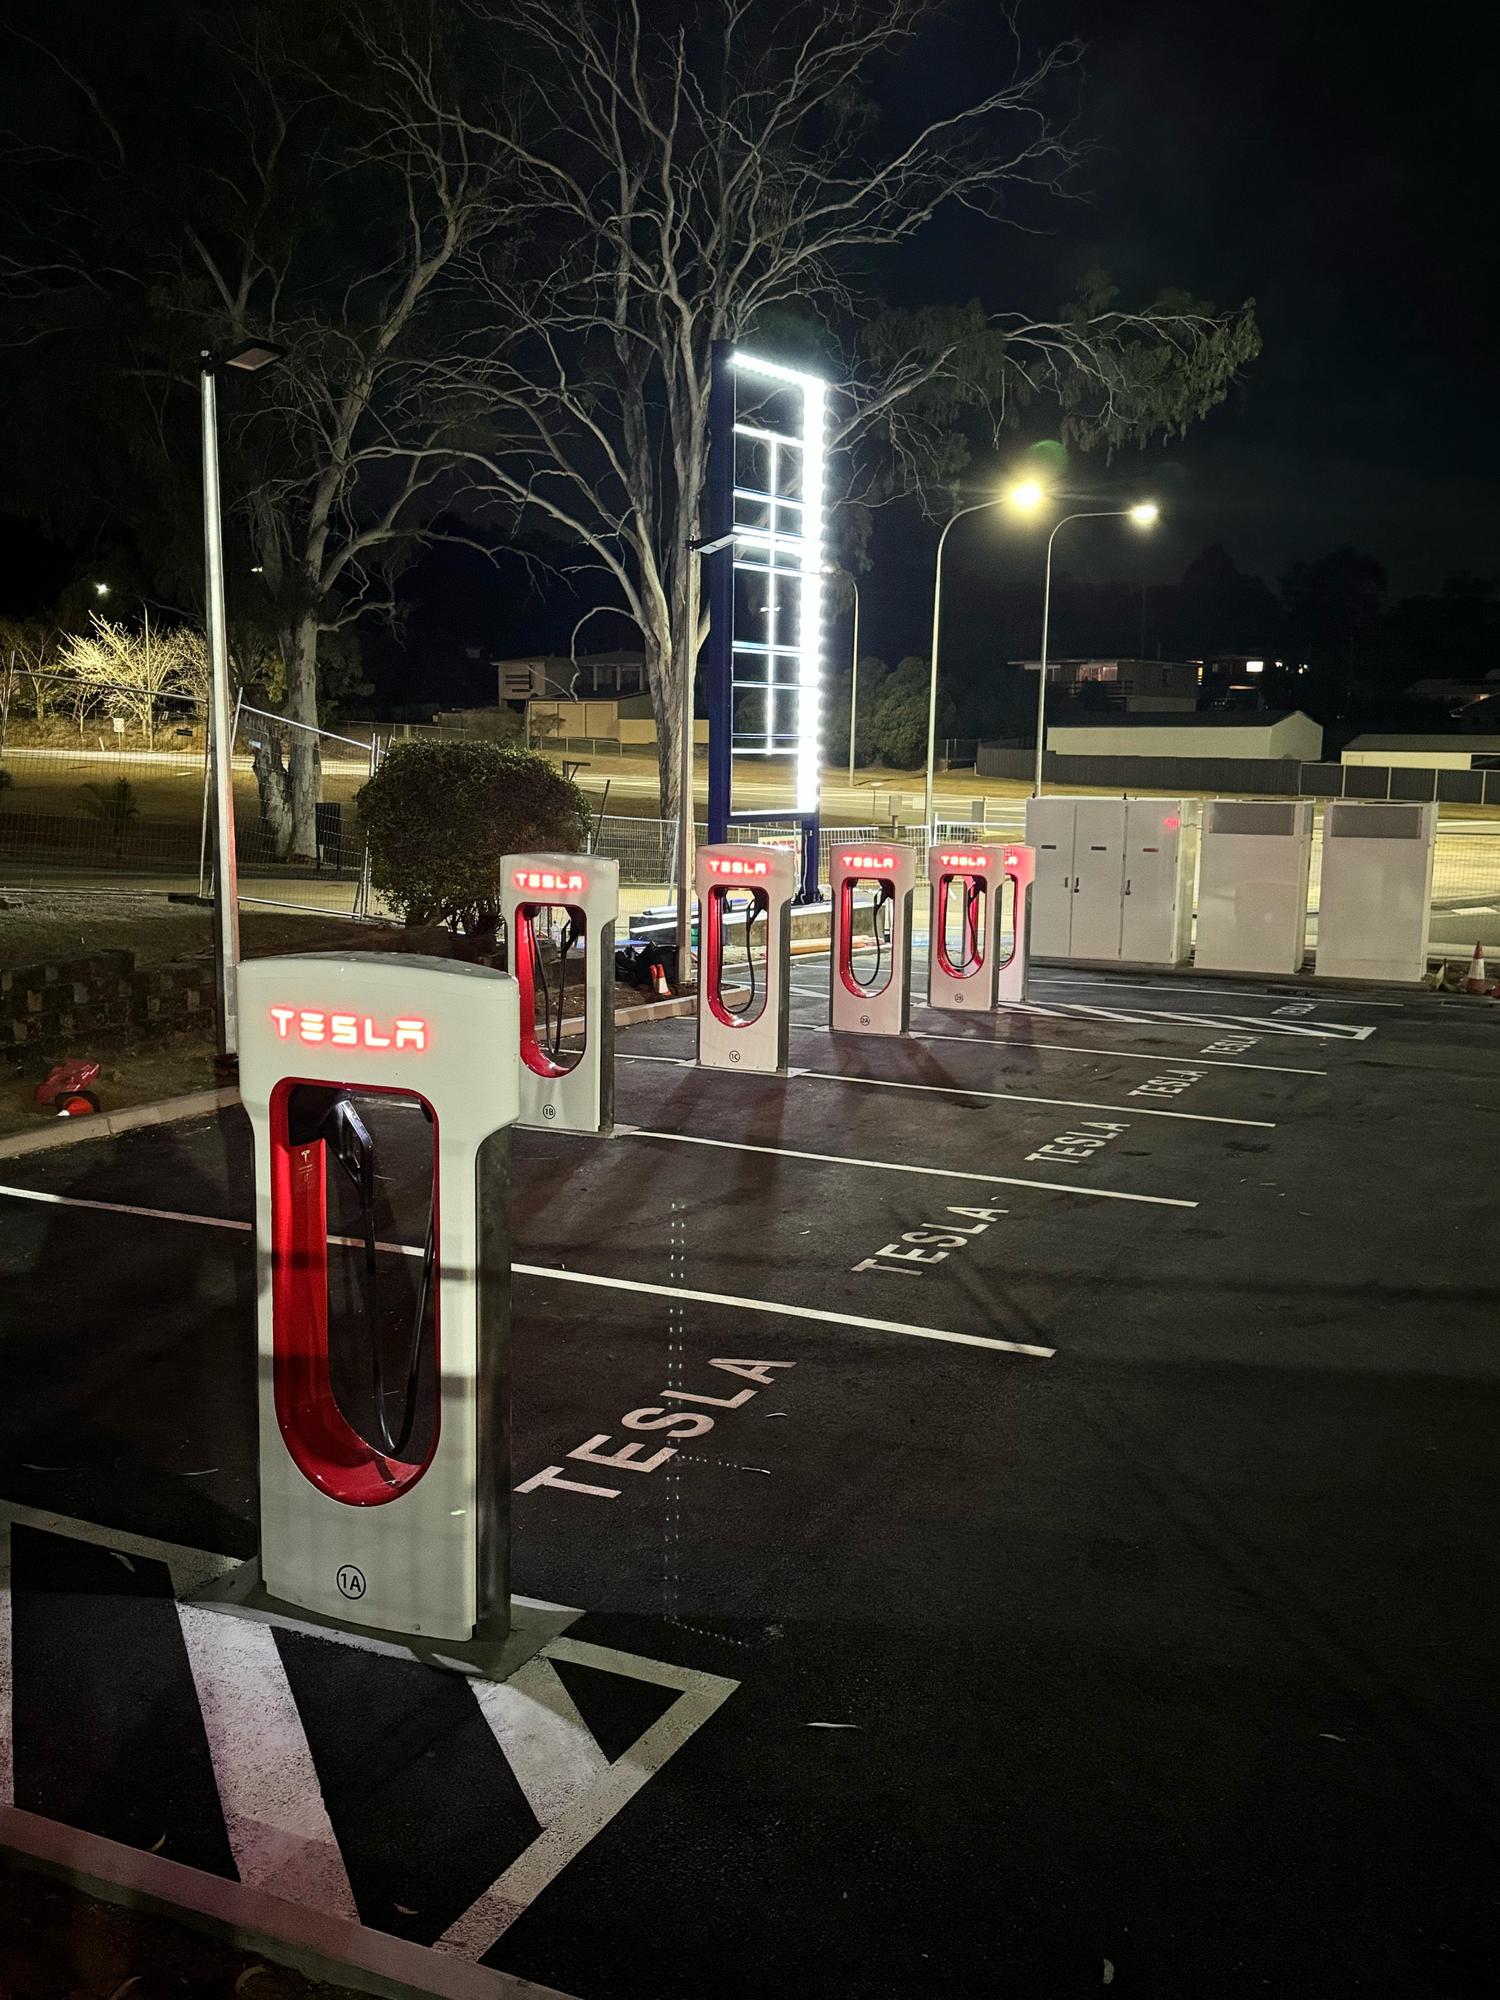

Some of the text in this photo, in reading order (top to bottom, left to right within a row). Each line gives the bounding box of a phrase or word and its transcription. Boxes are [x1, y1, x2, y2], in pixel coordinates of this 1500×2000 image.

[709, 860, 766, 874] TESLA
[843, 856, 894, 868] TESLA
[941, 855, 987, 867] TESLA
[515, 873, 582, 889] TESLA
[270, 1008, 425, 1049] TESLA
[1127, 1069, 1209, 1098] TESLA
[1024, 1121, 1131, 1164] TESLA
[851, 1206, 1009, 1276] TESLA
[513, 1358, 798, 1499] TESLA
